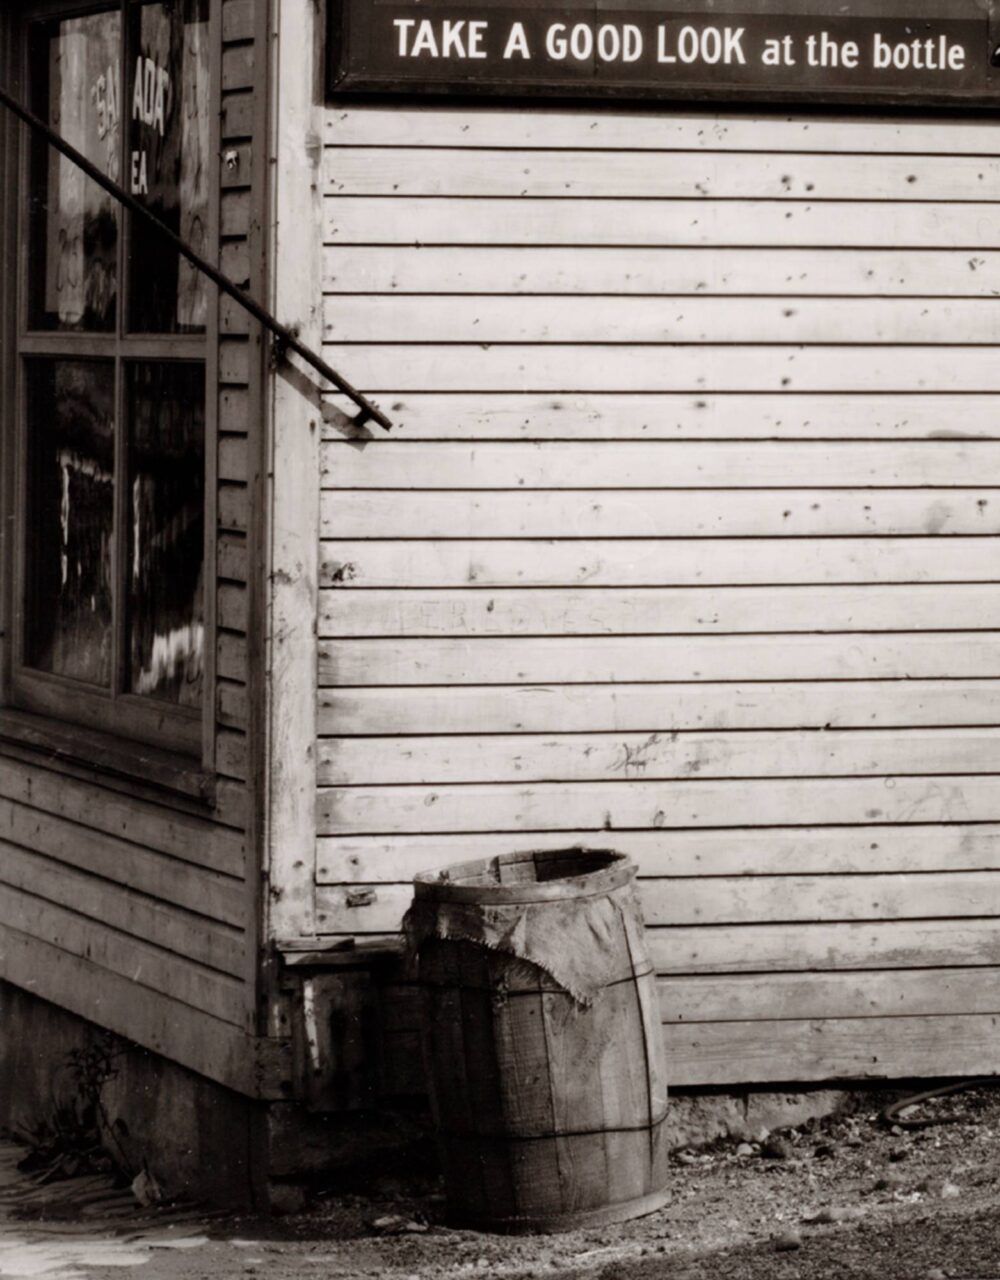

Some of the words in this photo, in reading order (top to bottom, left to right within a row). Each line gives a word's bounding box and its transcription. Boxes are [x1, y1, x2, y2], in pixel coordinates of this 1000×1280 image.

[394, 20, 487, 59] TAKE
[503, 23, 531, 59] A
[546, 23, 642, 62] GOOD
[658, 27, 746, 65] LOOK
[761, 33, 796, 66] at
[806, 32, 859, 68] the
[873, 34, 965, 70] bottle
